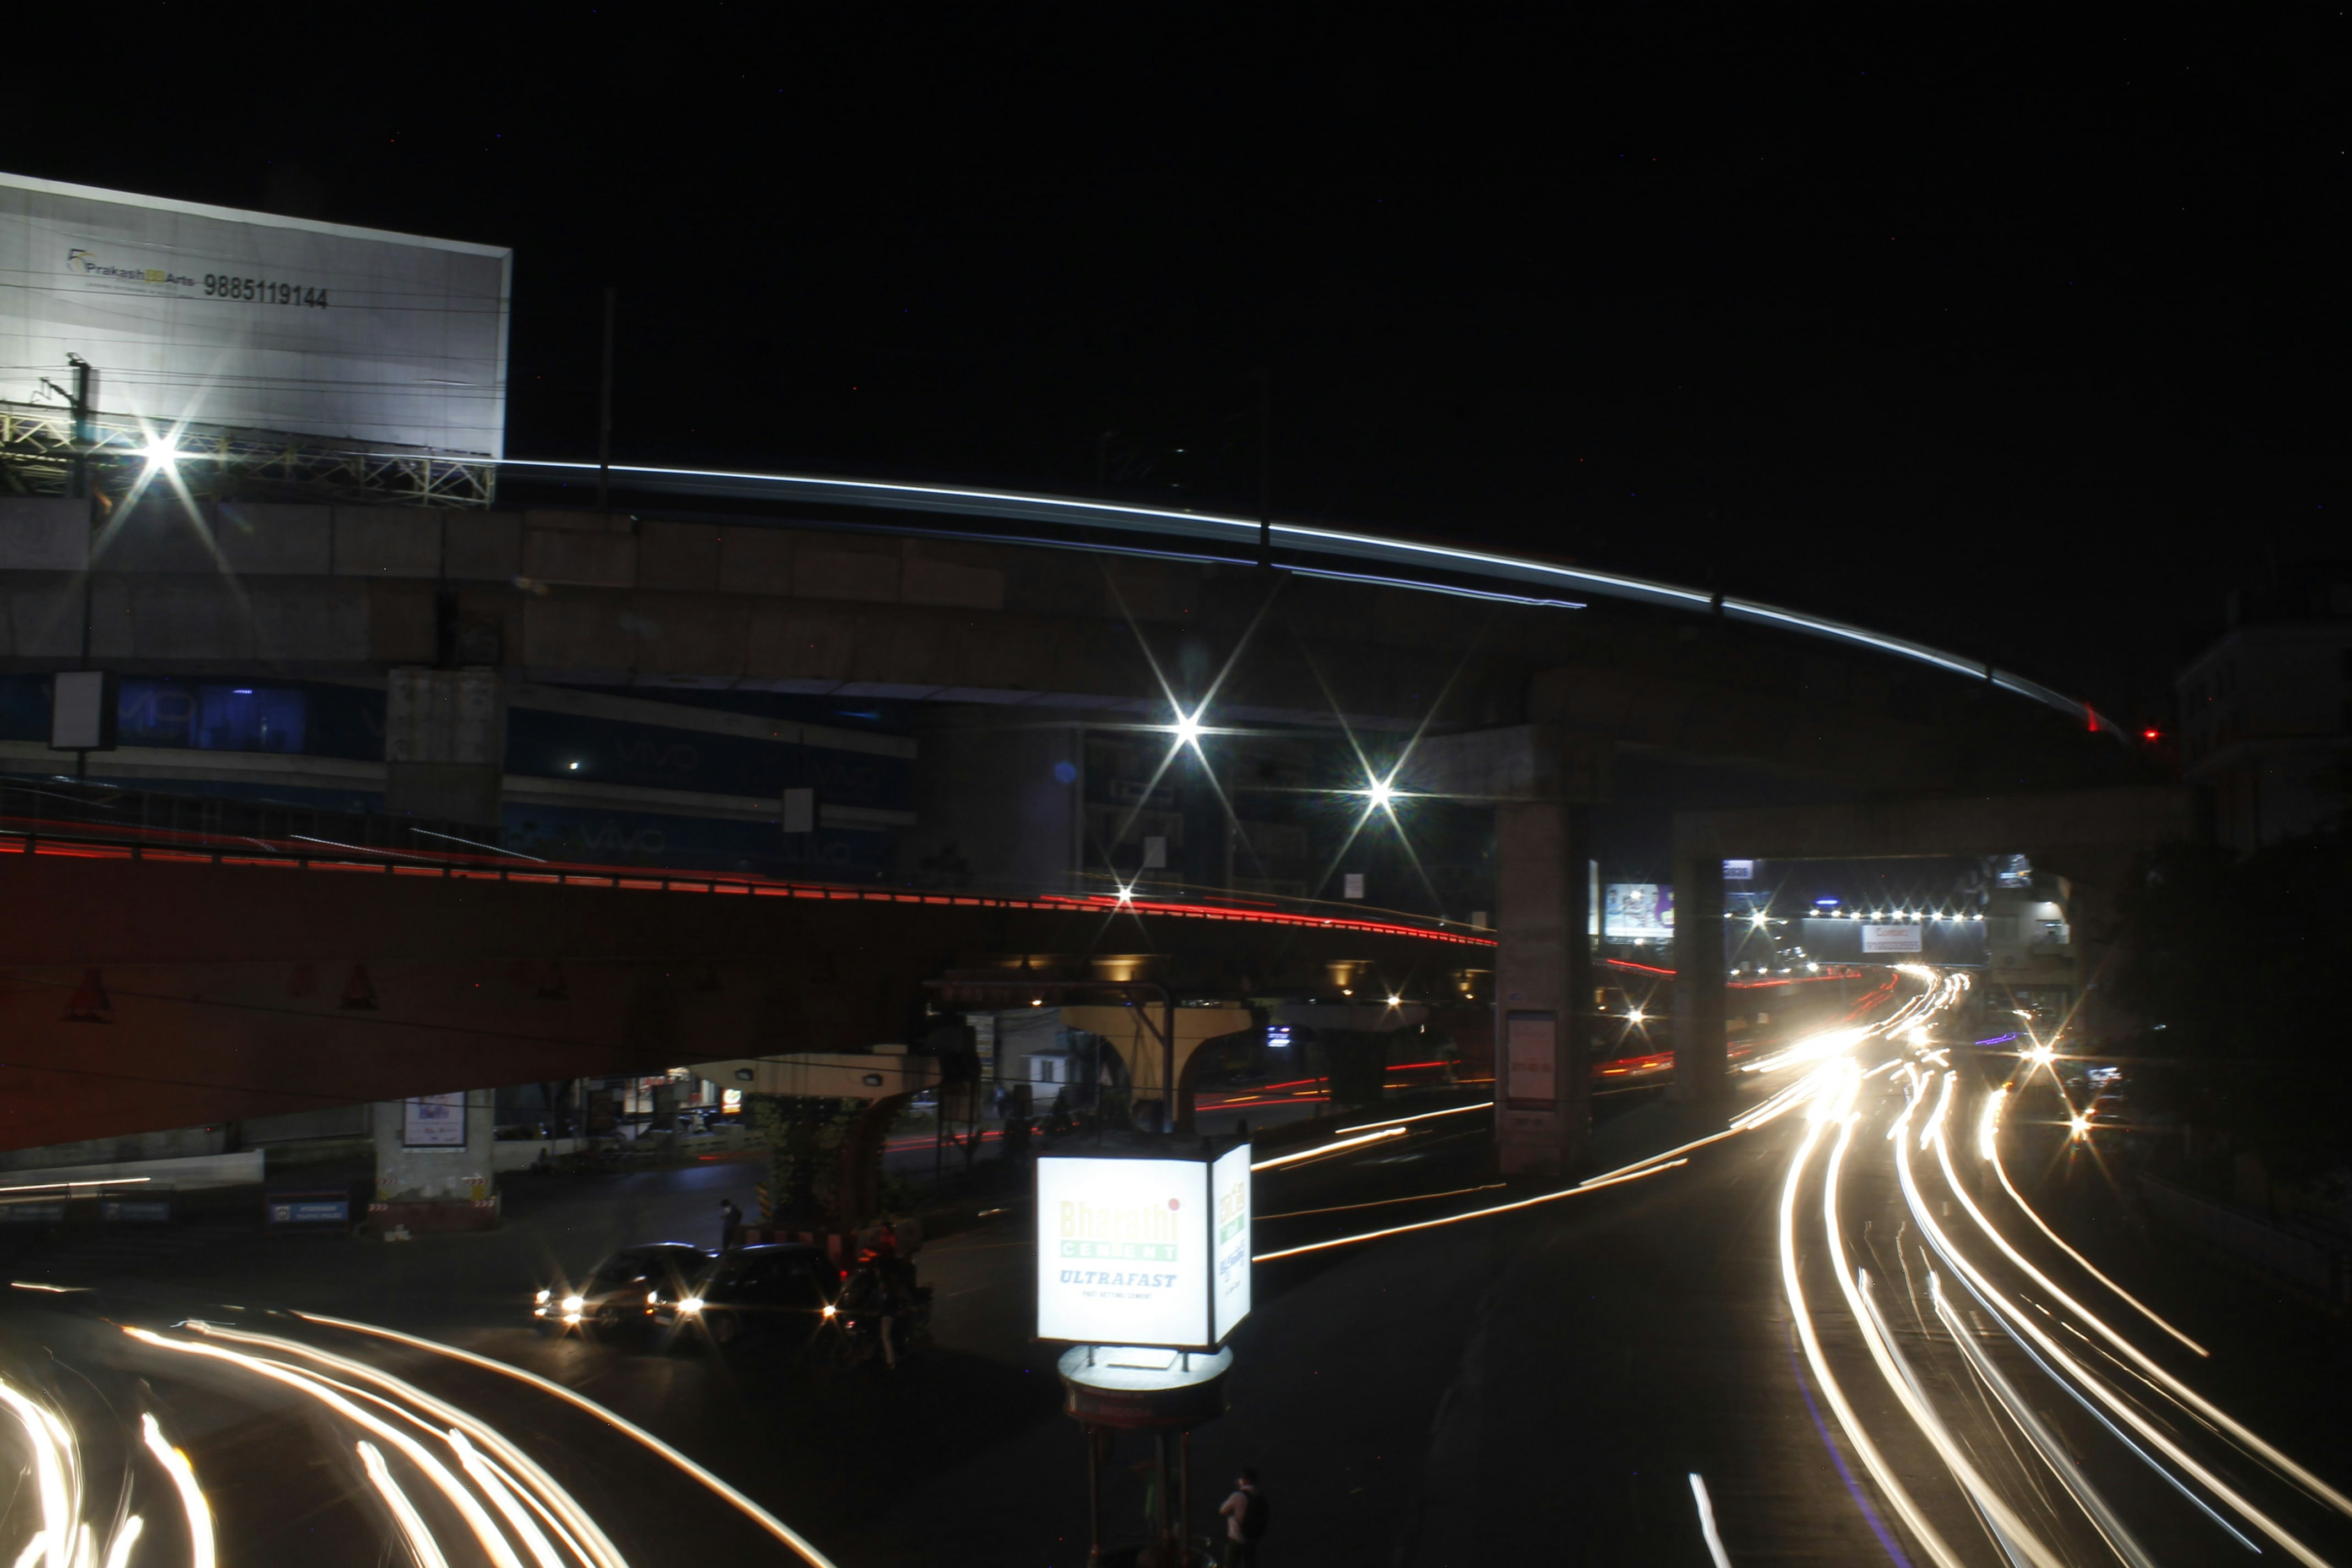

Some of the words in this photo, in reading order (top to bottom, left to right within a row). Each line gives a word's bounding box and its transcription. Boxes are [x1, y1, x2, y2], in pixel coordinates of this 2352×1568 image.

[85, 263, 145, 281] Prakash
[166, 273, 194, 287] Arts
[204, 274, 329, 309] 9885119144
[1060, 1197, 1180, 1256] Bharathi
[1063, 1242, 1177, 1260] CEMENT
[1060, 1270, 1178, 1288] ULTRAFAST
